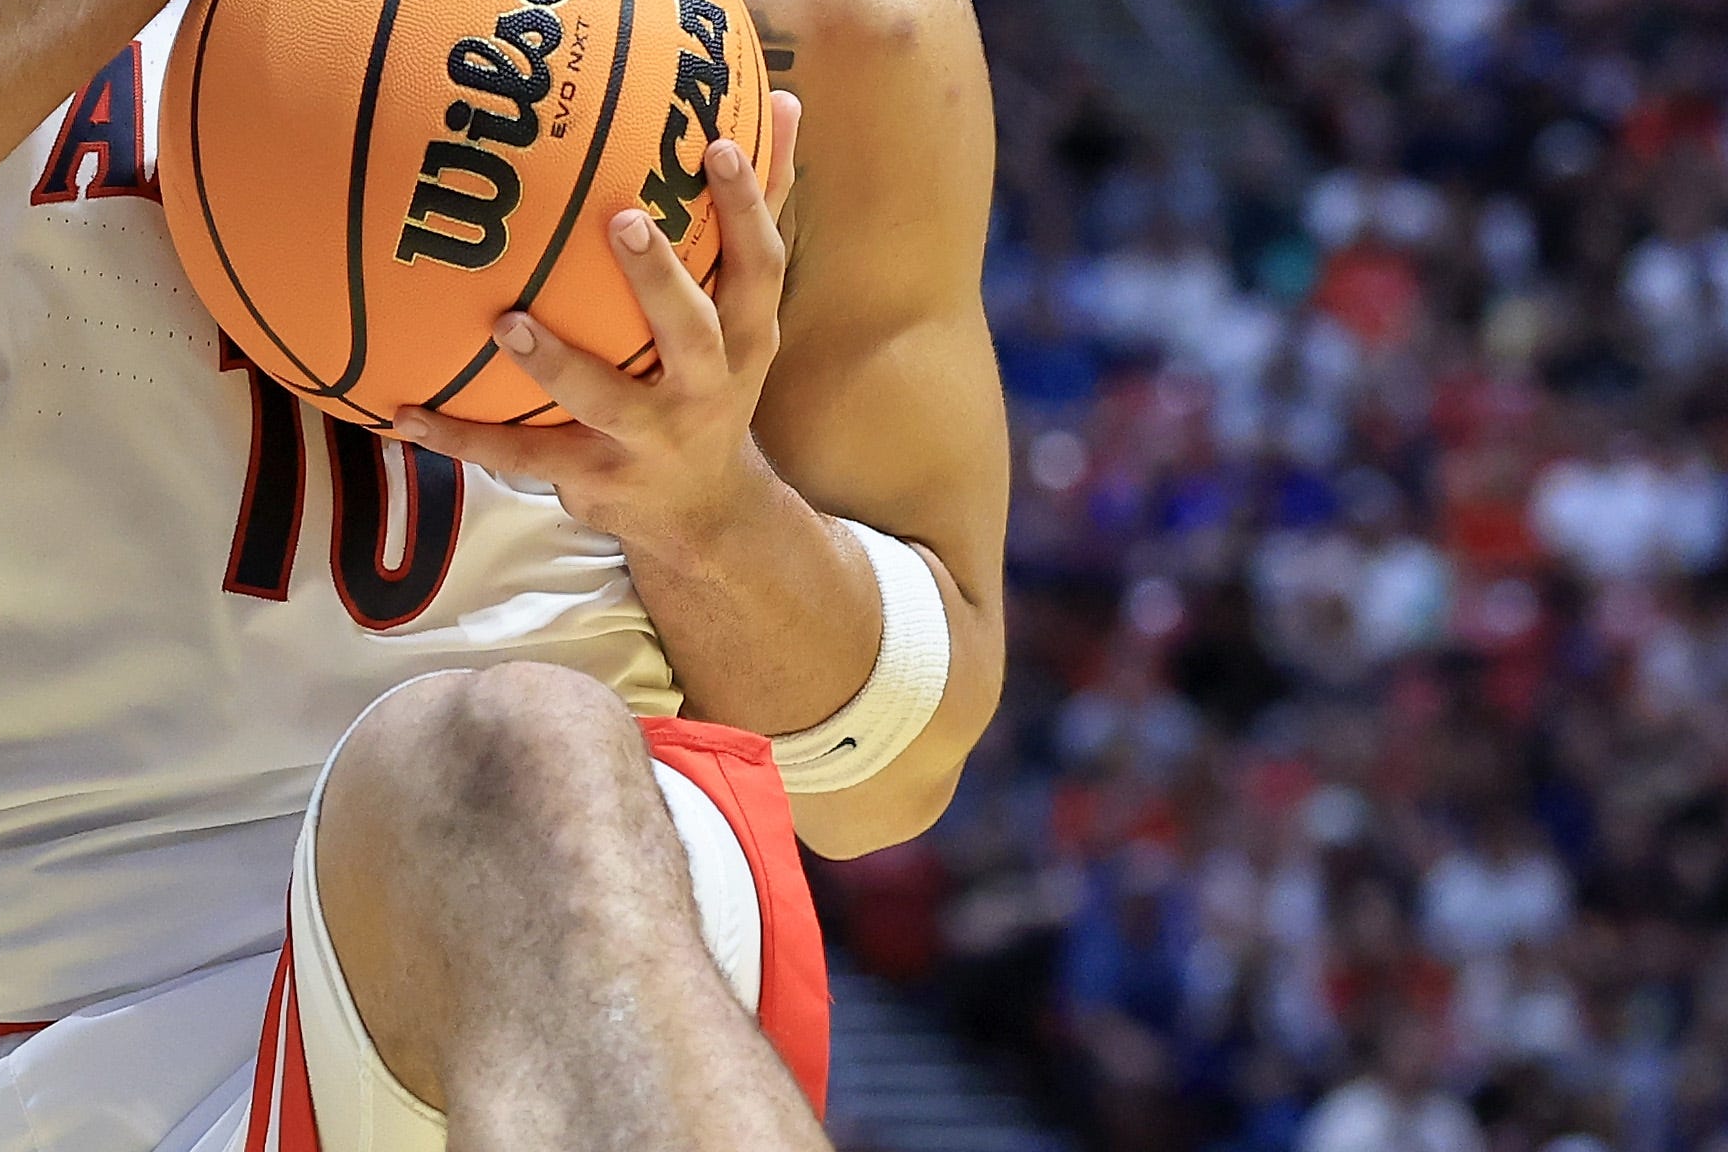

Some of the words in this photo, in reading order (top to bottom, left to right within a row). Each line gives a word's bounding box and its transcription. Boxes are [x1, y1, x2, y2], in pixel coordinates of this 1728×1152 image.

[551, 80, 576, 139] EVO
[566, 15, 589, 72] NXT
[220, 324, 464, 630] 10
